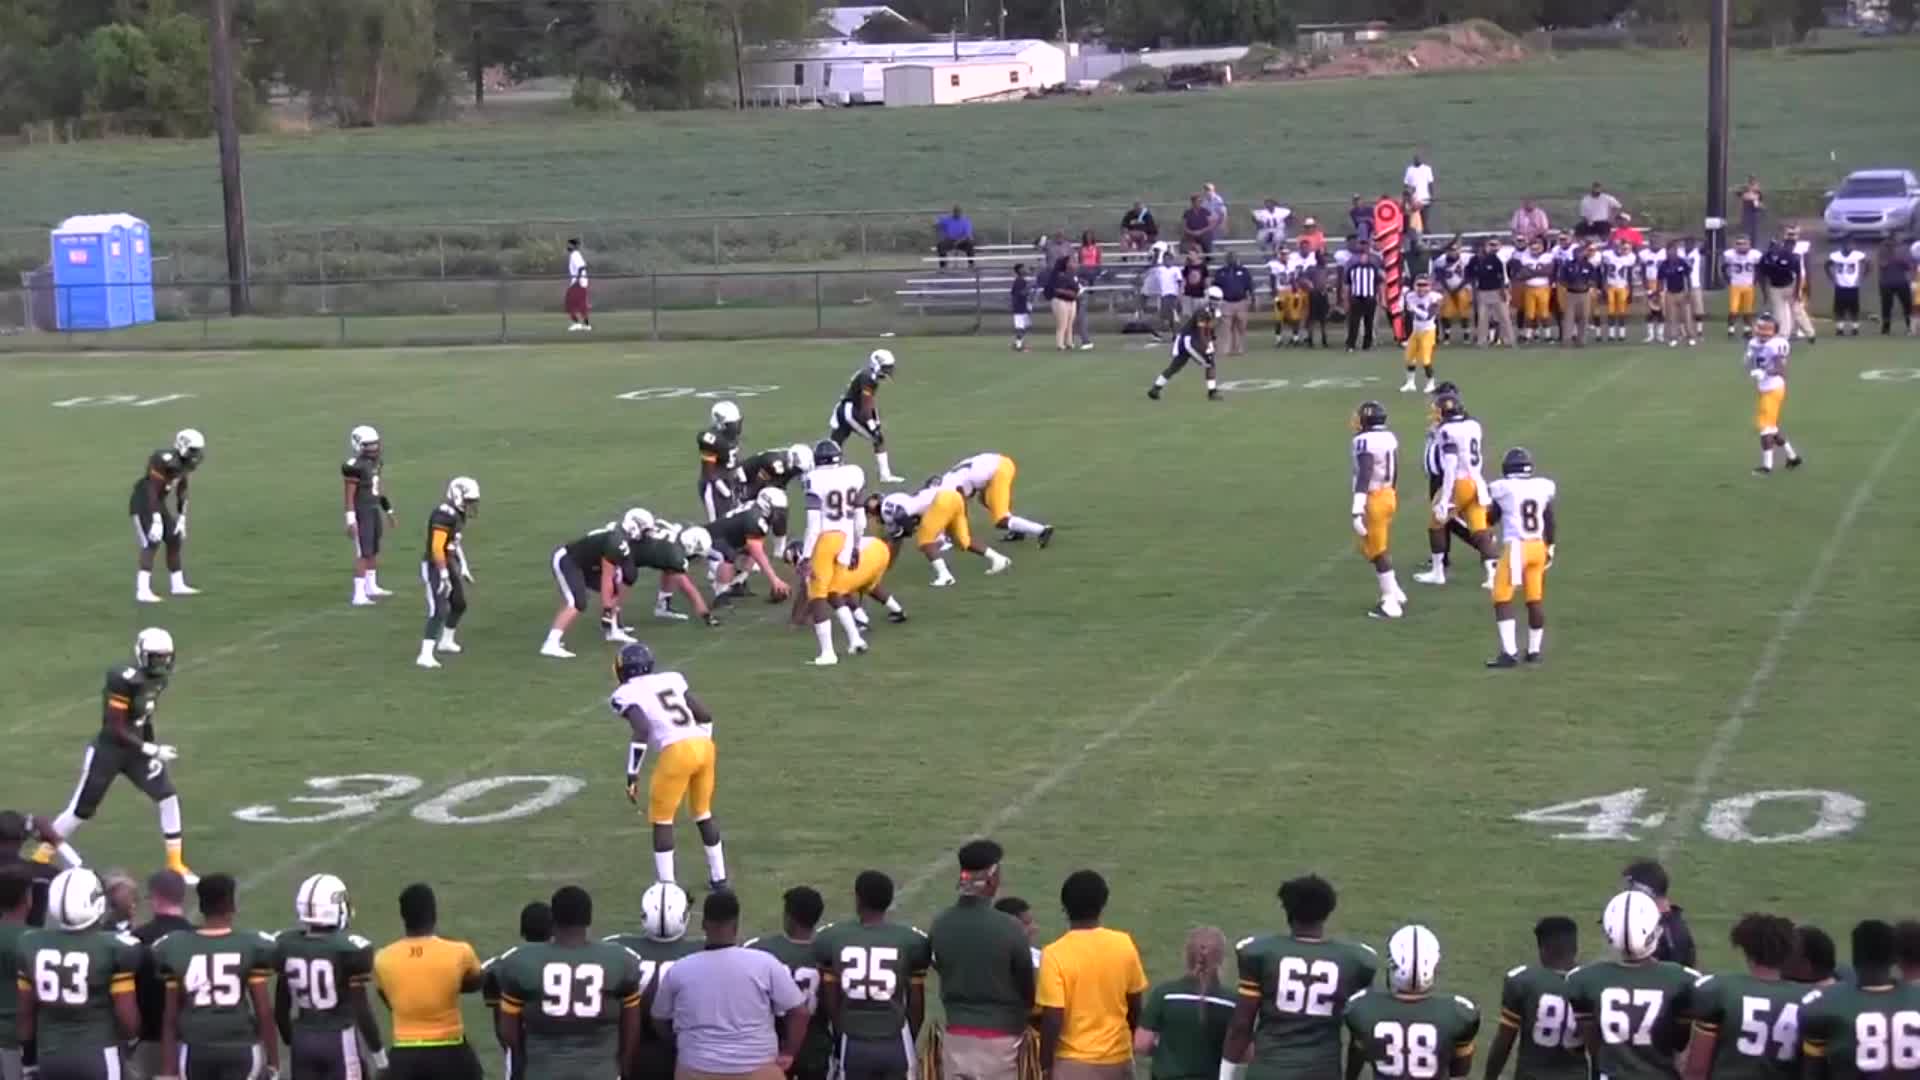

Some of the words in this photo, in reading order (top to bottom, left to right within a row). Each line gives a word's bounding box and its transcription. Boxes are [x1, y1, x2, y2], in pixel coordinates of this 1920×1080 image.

[1469, 437, 1480, 467] 9
[1521, 498, 1540, 533] 8
[656, 687, 690, 727] 5
[232, 773, 588, 824] 30
[1512, 788, 1866, 843] 40
[34, 949, 90, 1005] 63
[184, 952, 242, 1007] 45
[284, 957, 338, 1011] 20
[541, 961, 606, 1018] 93
[840, 946, 899, 1001] 25
[1276, 956, 1340, 1017] 62
[1600, 987, 1664, 1046] 67
[1736, 995, 1799, 1061] 54
[1855, 1010, 1920, 1071] 86
[1373, 1020, 1438, 1078] 38
